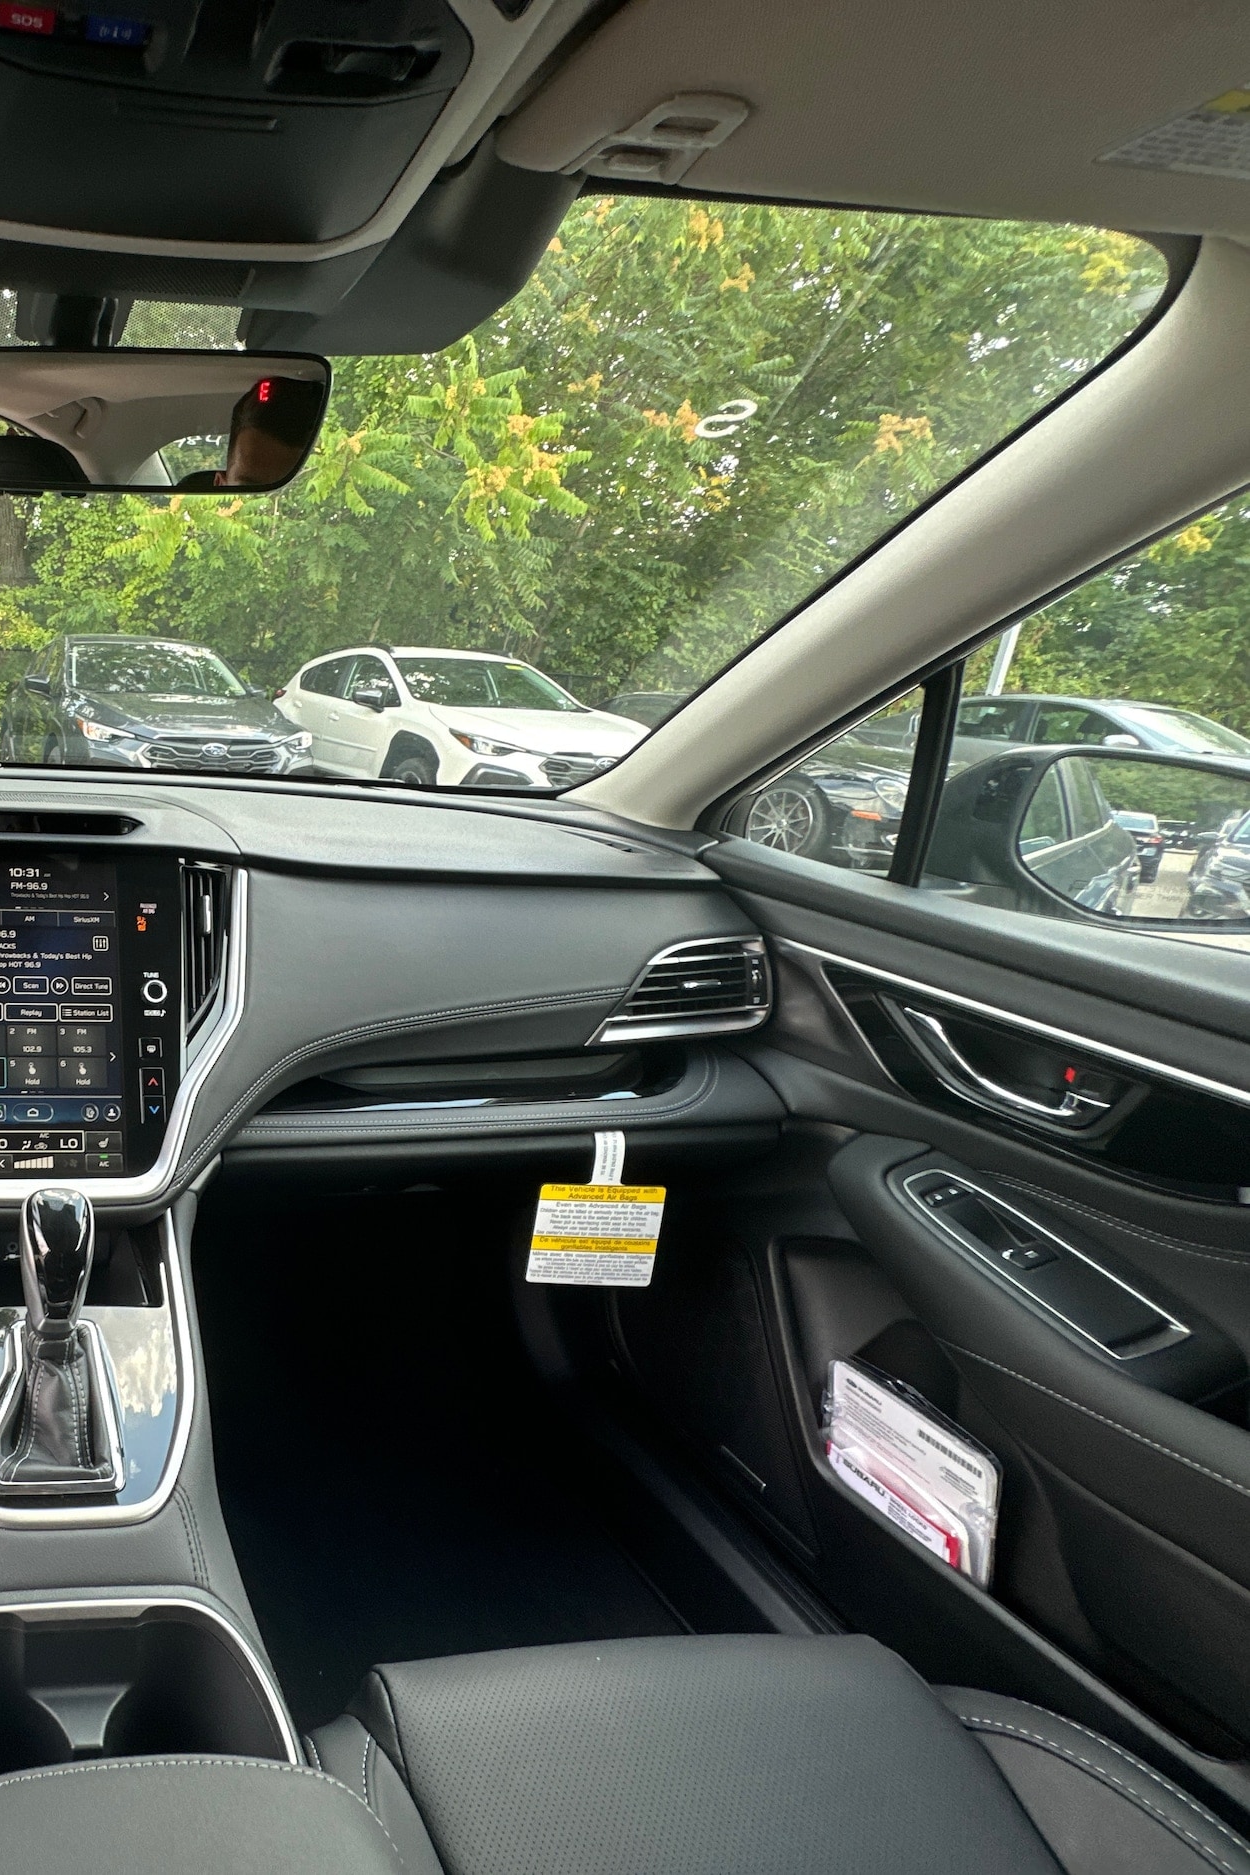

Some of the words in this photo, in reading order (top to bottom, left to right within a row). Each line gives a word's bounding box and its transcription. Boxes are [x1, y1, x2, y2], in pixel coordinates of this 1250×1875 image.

[11, 13, 43, 28] SOS
[259, 382, 270, 402] E
[8, 868, 40, 878] 10:31
[10, 882, 48, 890] FM-96.9
[40, 952, 64, 960] Today's
[82, 953, 92, 961] Hip
[20, 1008, 42, 1018] Replay
[59, 1138, 78, 1149] LO
[606, 1186, 640, 1194] Equipped
[842, 1458, 886, 1497] SUBARU
